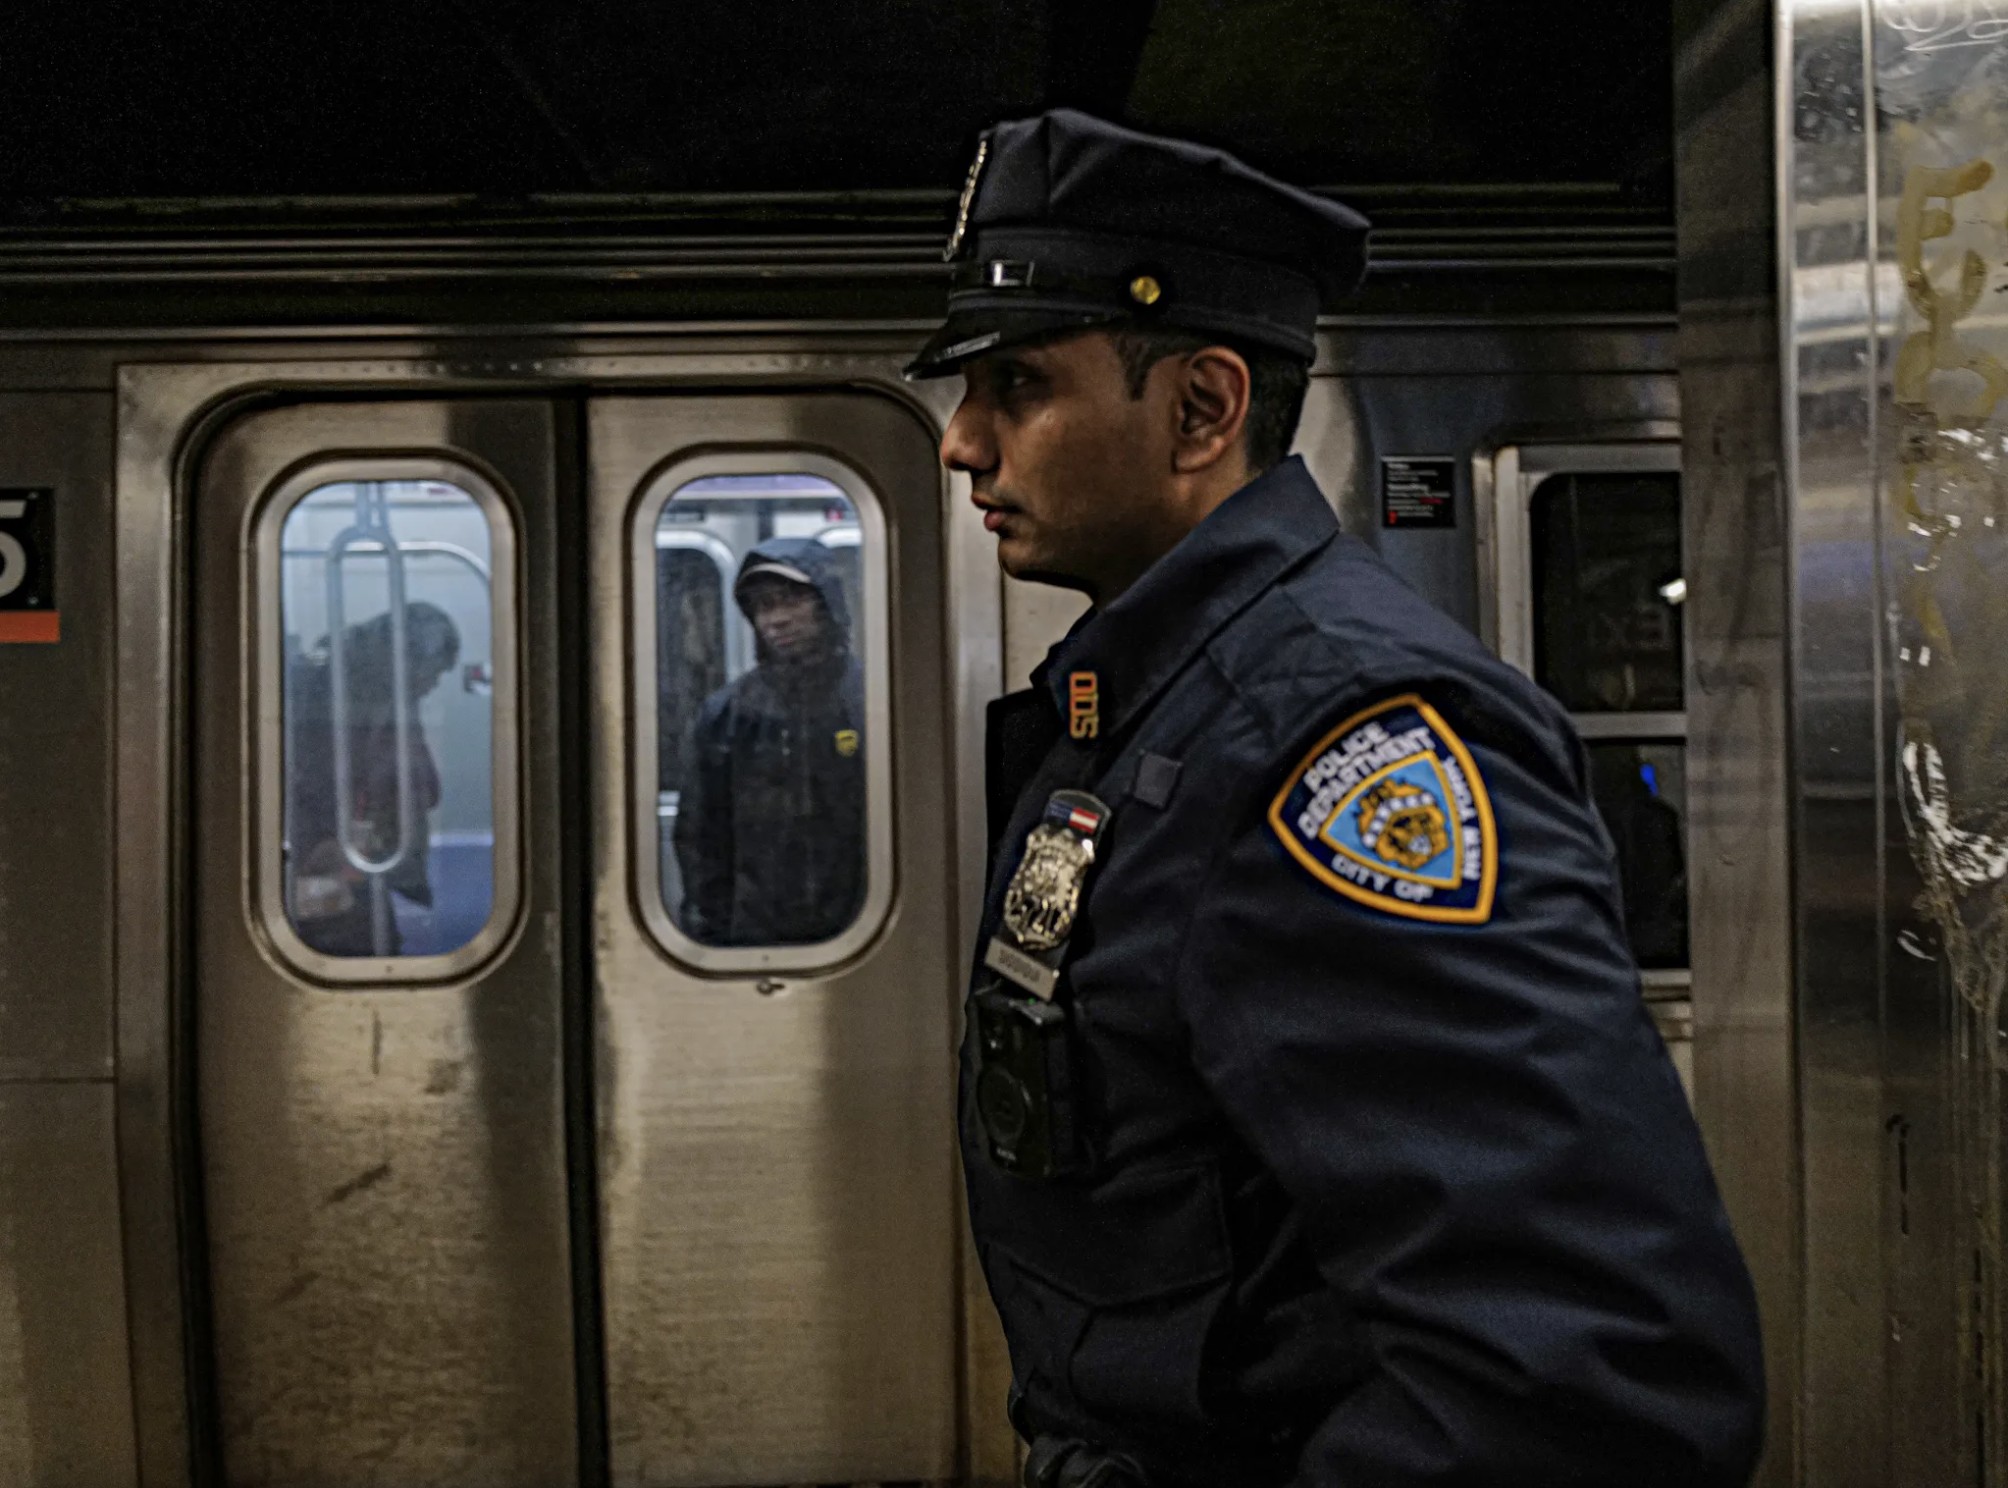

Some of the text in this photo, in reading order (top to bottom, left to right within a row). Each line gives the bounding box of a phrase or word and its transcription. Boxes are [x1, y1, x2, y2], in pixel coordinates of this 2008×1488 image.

[1297, 727, 1436, 840] DEPARTMENT
[1303, 721, 1389, 794] POLICE
[1331, 853, 1391, 891] CITY
